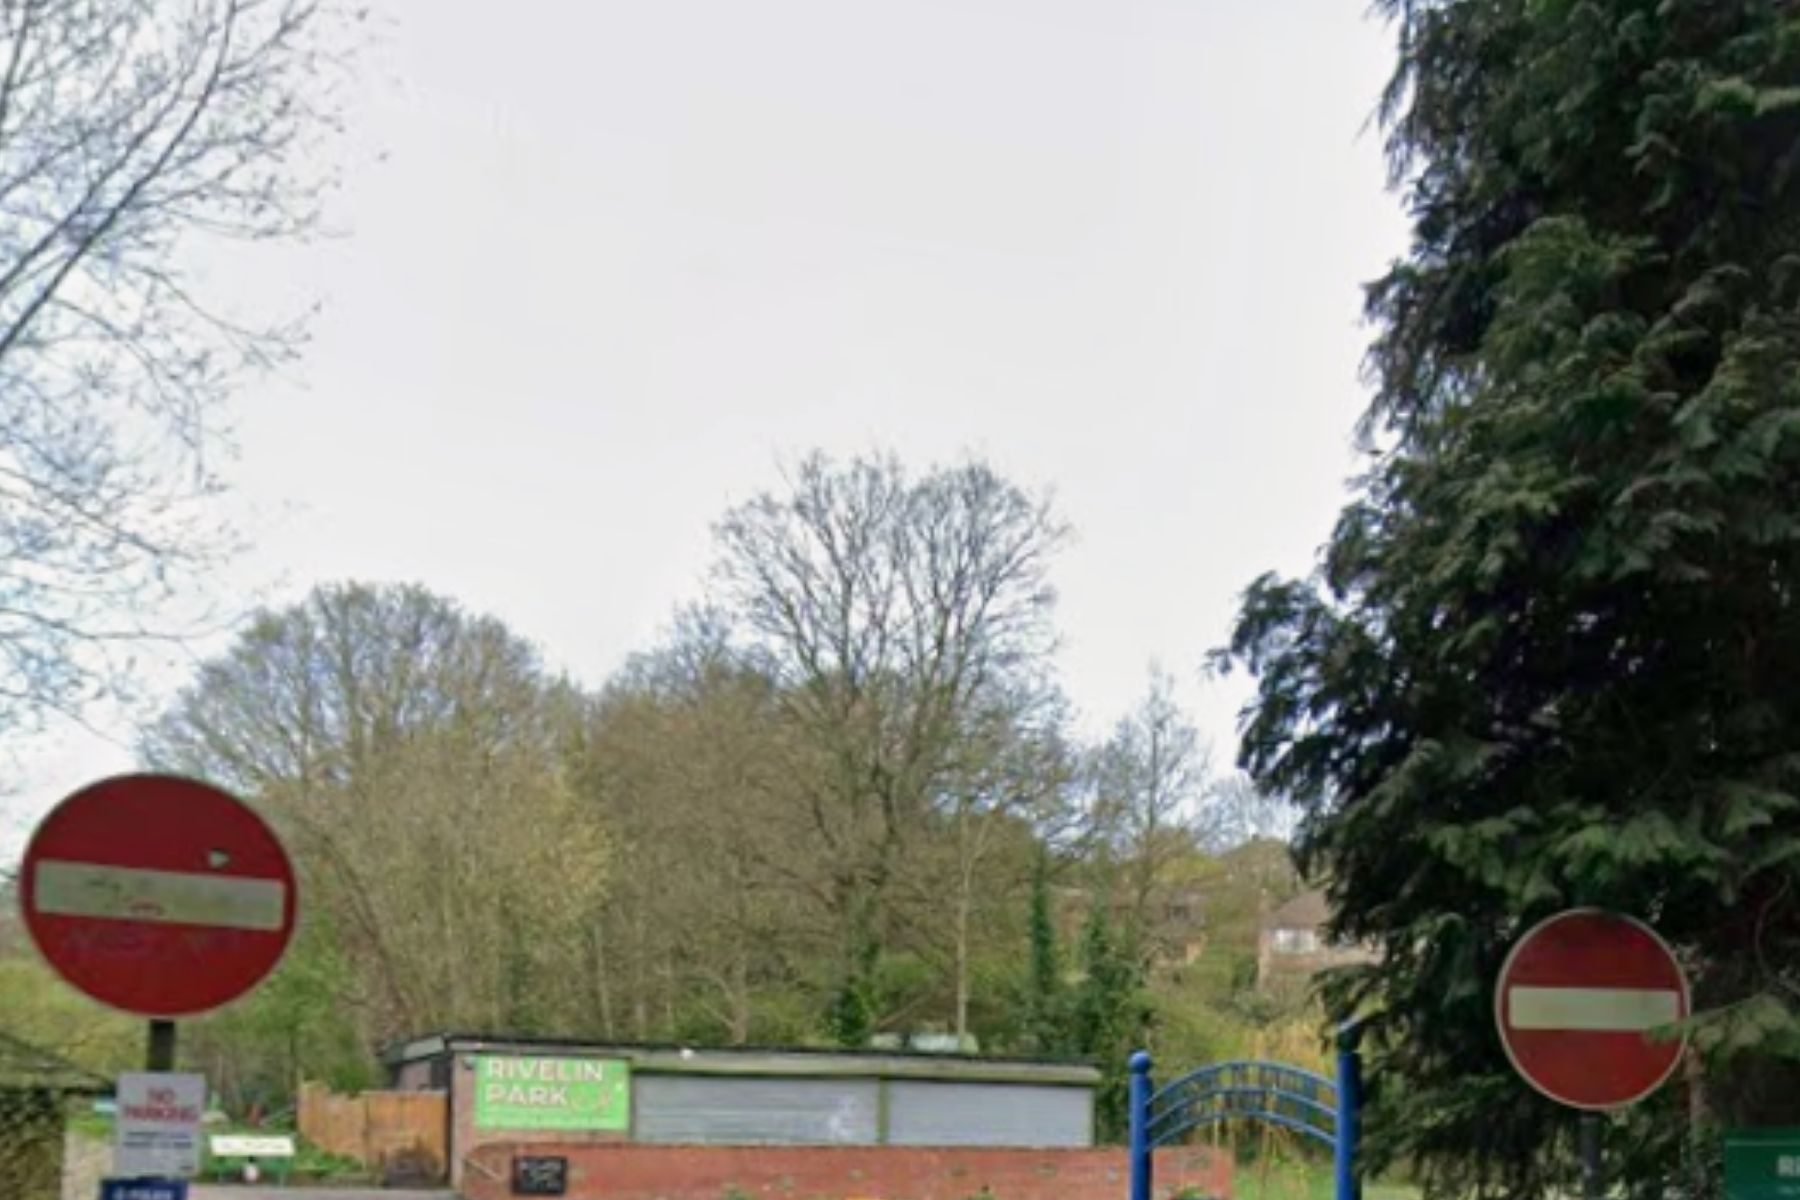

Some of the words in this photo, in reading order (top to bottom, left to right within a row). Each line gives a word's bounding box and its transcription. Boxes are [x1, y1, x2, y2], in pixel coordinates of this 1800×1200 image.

[488, 1056, 603, 1081] RIVELIN
[147, 1087, 176, 1103] NO
[485, 1083, 568, 1106] PARK
